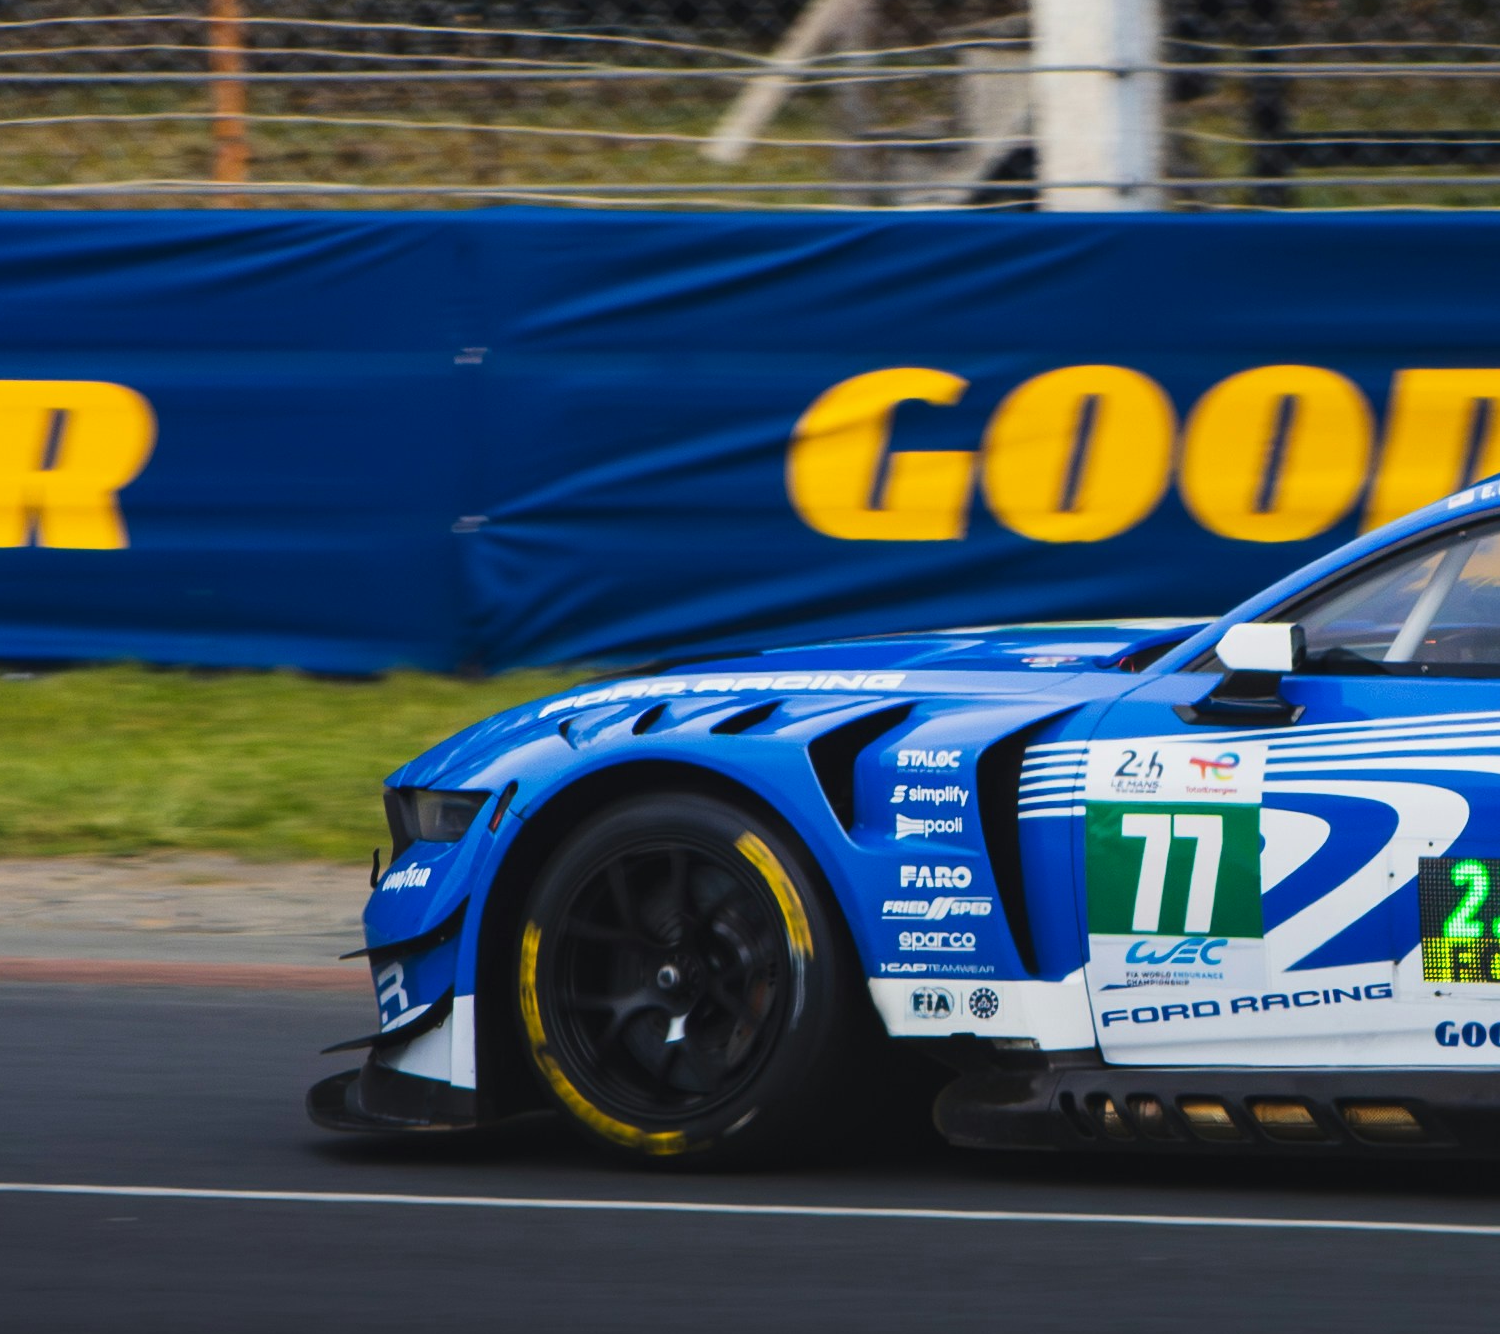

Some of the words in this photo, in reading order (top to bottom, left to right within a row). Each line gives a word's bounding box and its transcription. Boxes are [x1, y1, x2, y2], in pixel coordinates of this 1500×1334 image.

[692, 673, 906, 693] RACING
[896, 749, 962, 768] STALOC
[908, 784, 969, 808] simplify
[924, 816, 963, 839] paoli
[900, 865, 972, 889] FARO
[899, 931, 976, 952] sparco
[1125, 937, 1229, 966] WEC
[912, 992, 951, 1012] FIA
[1101, 999, 1221, 1028] FORD
[1231, 982, 1394, 1015] RACING
